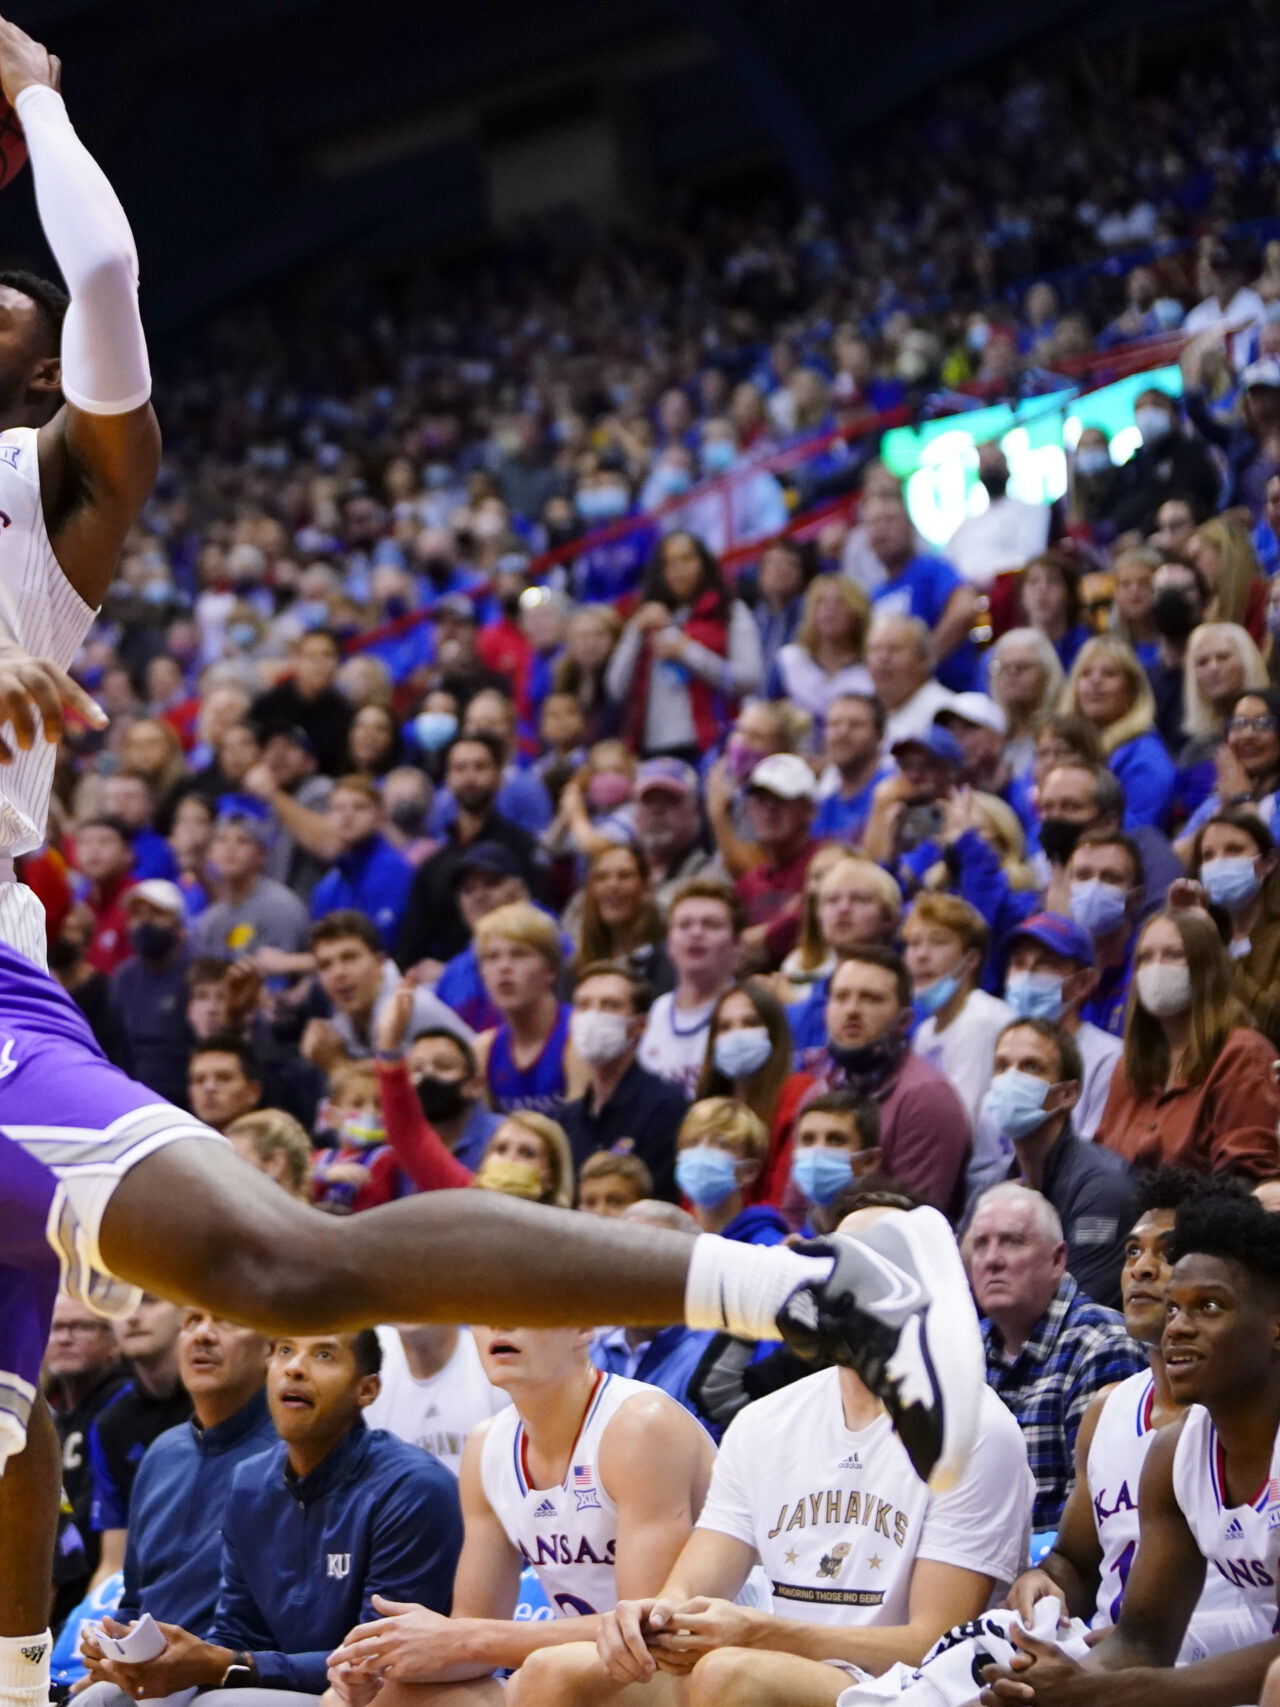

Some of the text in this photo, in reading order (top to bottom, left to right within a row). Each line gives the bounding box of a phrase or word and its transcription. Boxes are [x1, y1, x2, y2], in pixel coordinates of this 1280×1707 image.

[838, 1462, 863, 1470] adidas
[768, 1489, 909, 1548] JAYHAWKS
[517, 1534, 616, 1565] NSAS
[327, 1553, 352, 1579] KU
[815, 1591, 843, 1601] THOSE
